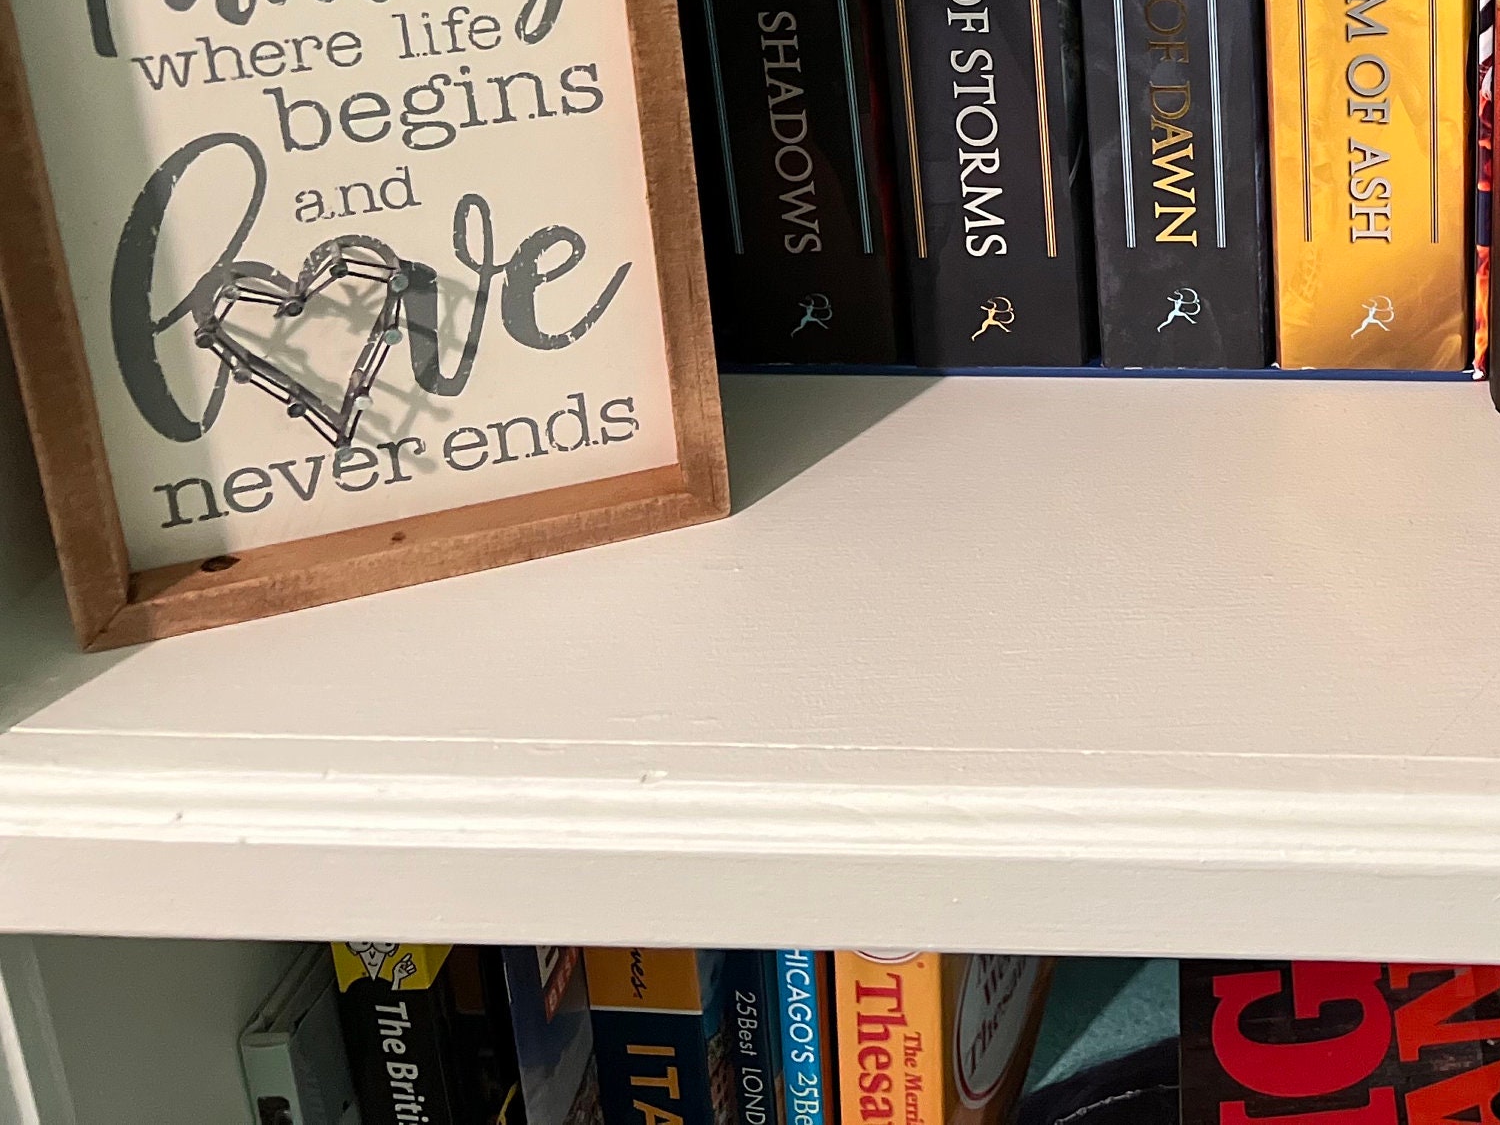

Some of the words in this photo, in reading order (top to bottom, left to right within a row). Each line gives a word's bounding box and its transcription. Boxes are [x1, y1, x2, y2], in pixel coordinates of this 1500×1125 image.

[131, 30, 363, 91] where
[392, 6, 502, 61] life
[1346, 54, 1392, 126] OF
[263, 62, 605, 152] begins
[760, 10, 822, 255] SHADOWS
[295, 166, 422, 224] and
[949, 47, 1008, 258] STORMS
[1148, 79, 1199, 249] DAWN
[1349, 142, 1393, 246] ASH
[153, 435, 427, 530] never
[444, 392, 640, 471] ends
[374, 1001, 412, 1055] The
[735, 990, 758, 1056] 25Best
[855, 972, 908, 1125] Thesa
[903, 1031, 922, 1069] The
[386, 1061, 432, 1125] Briti
[905, 1072, 924, 1125] Merri
